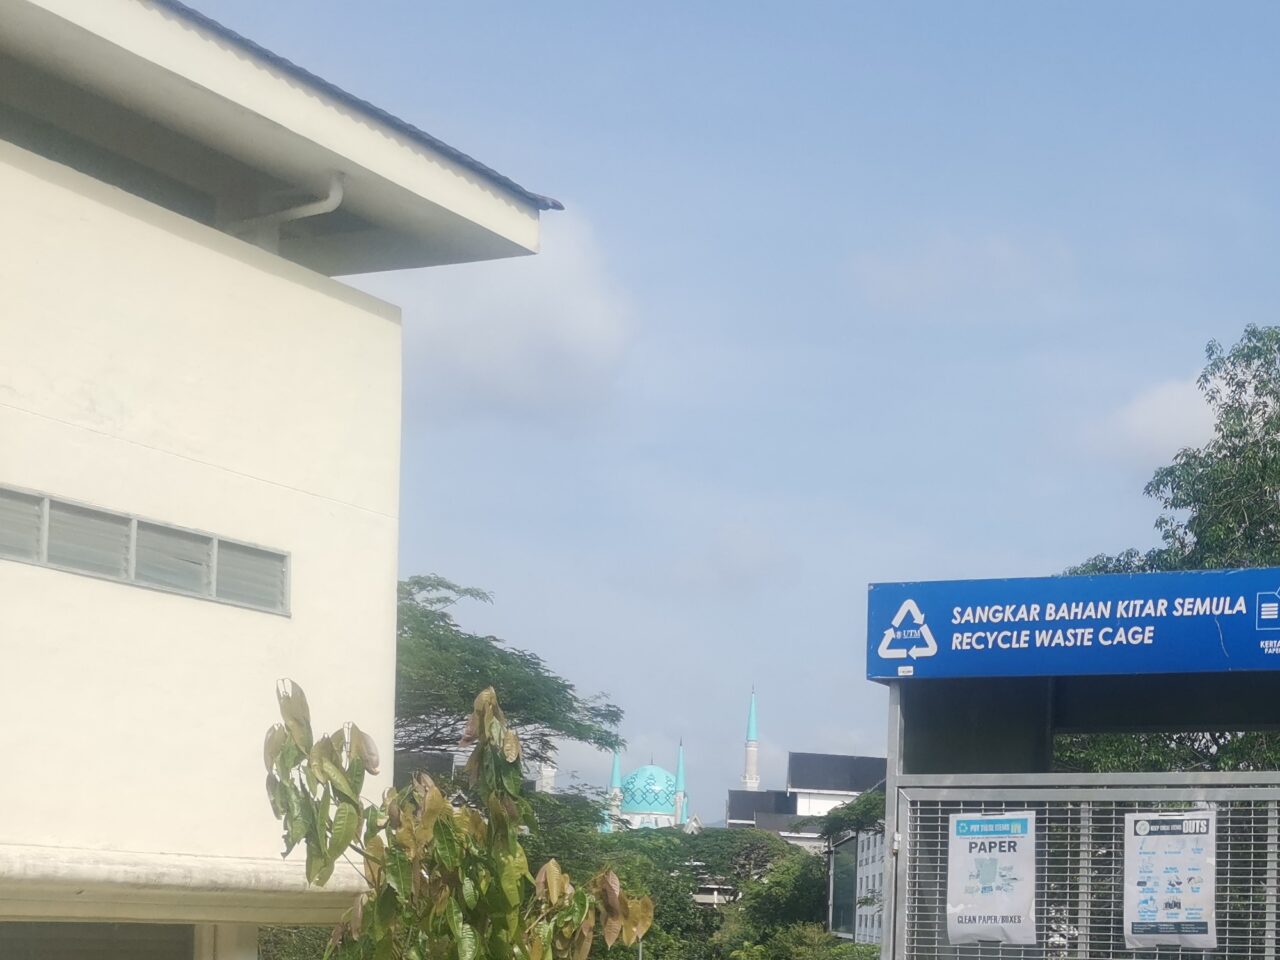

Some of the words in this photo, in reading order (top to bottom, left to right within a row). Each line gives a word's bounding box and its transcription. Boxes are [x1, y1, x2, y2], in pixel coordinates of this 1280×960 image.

[951, 604, 1040, 624] SANGKAR
[1045, 601, 1111, 621] BAHAN
[1116, 599, 1168, 618] KITAR
[1172, 596, 1247, 616] SEMULA
[951, 630, 1030, 650] RECYCLE
[1035, 628, 1094, 647] WASTE
[1098, 626, 1154, 645] CAGE
[1183, 820, 1207, 833] OUTS
[969, 841, 1017, 853] PAPER
[957, 915, 977, 924] CLEAN
